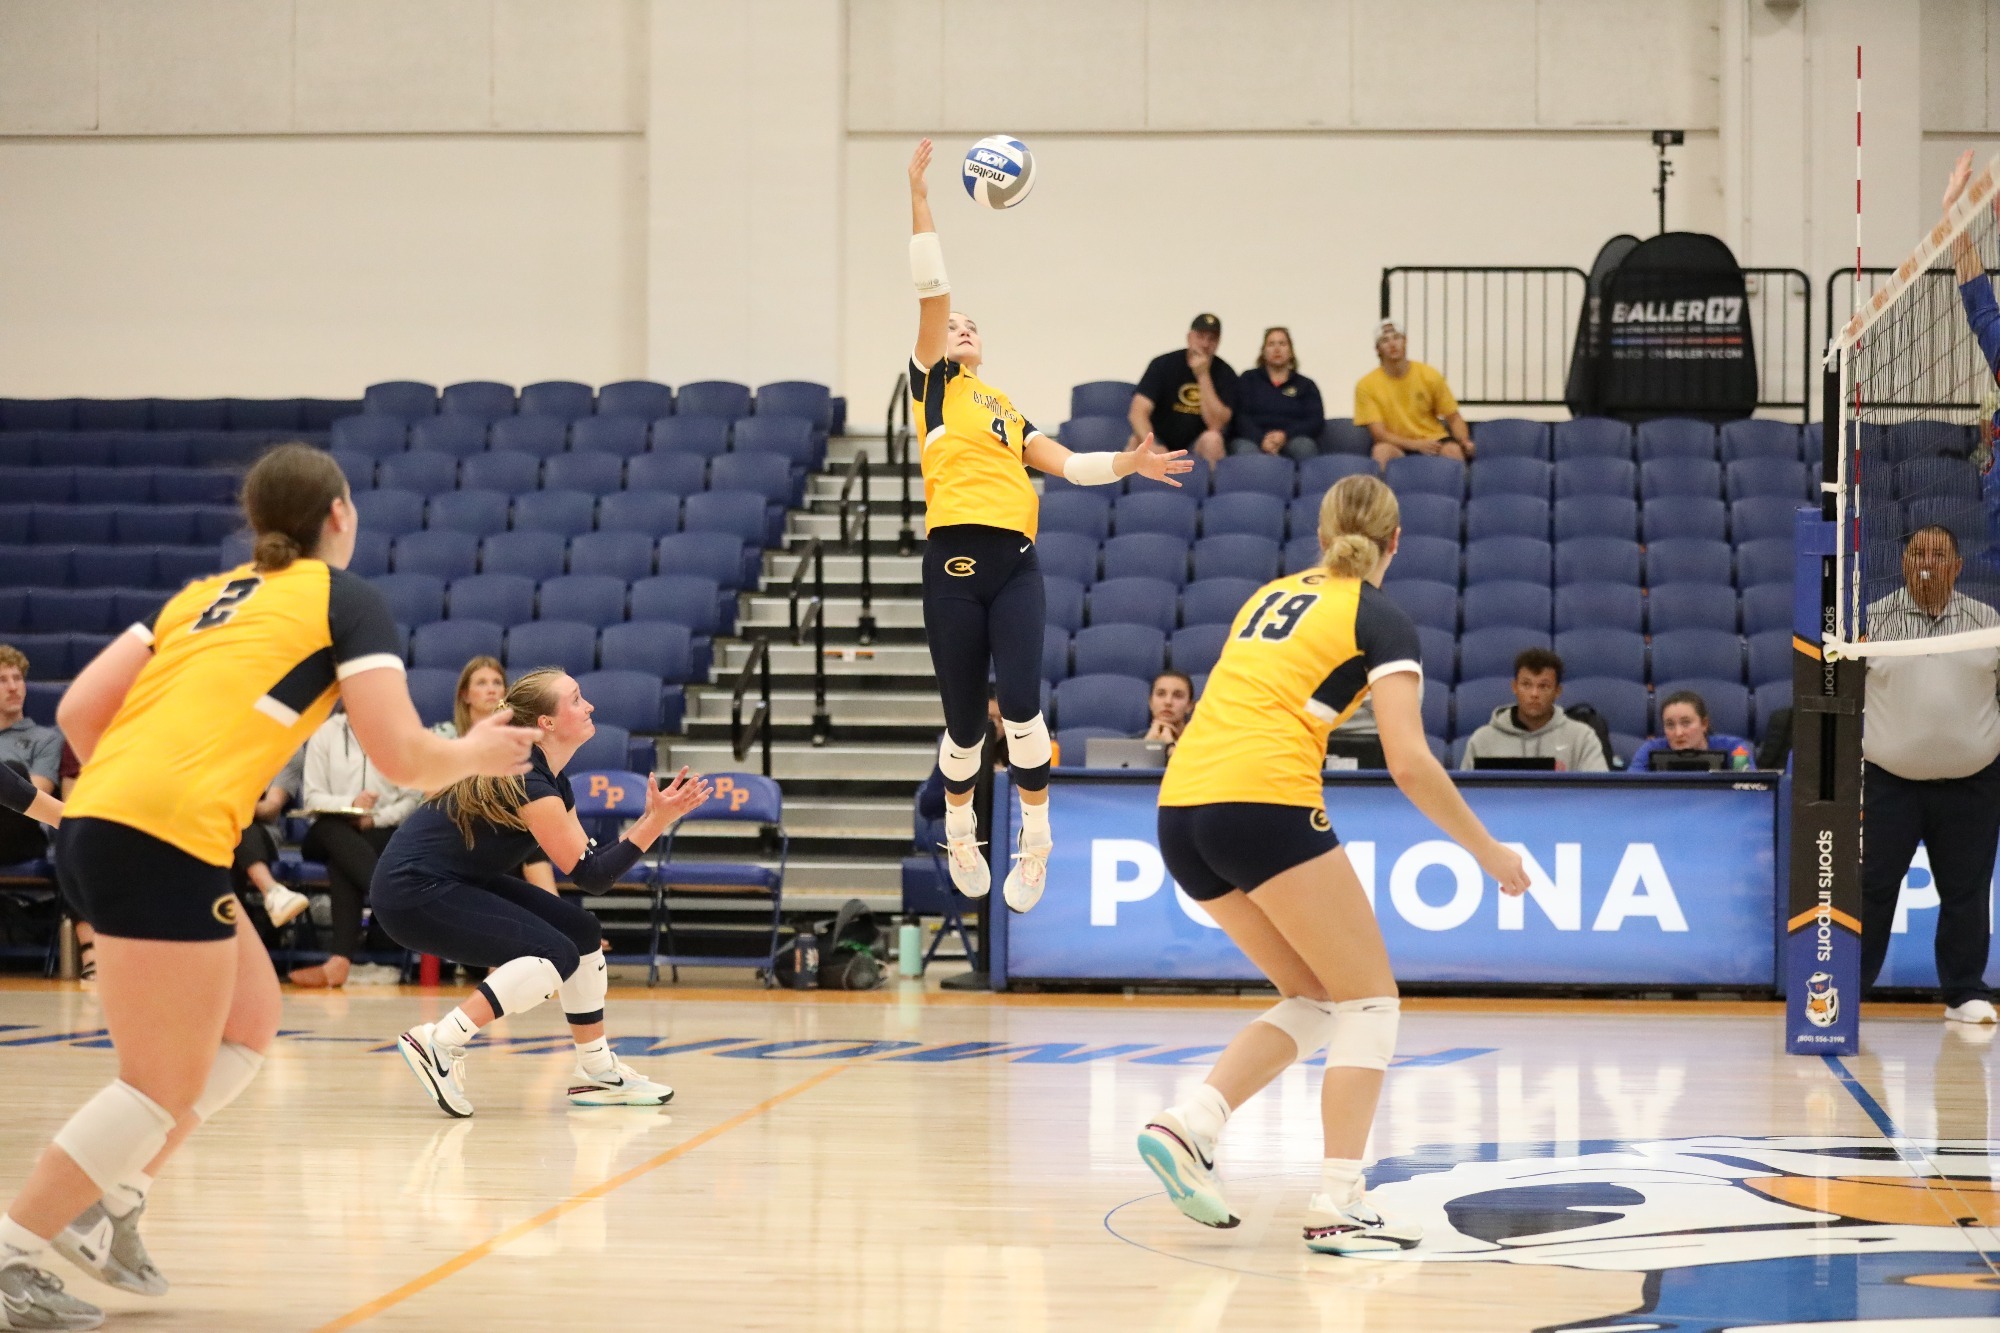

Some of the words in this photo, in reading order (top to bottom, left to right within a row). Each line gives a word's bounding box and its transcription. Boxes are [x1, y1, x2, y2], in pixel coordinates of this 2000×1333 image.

[968, 163, 1005, 182] molten
[992, 417, 1009, 447] 4
[191, 576, 261, 632] 2
[1237, 590, 1319, 642] 19
[1091, 838, 1690, 932] PONA
[1816, 830, 1834, 888] sports
[1815, 891, 1833, 961] imports
